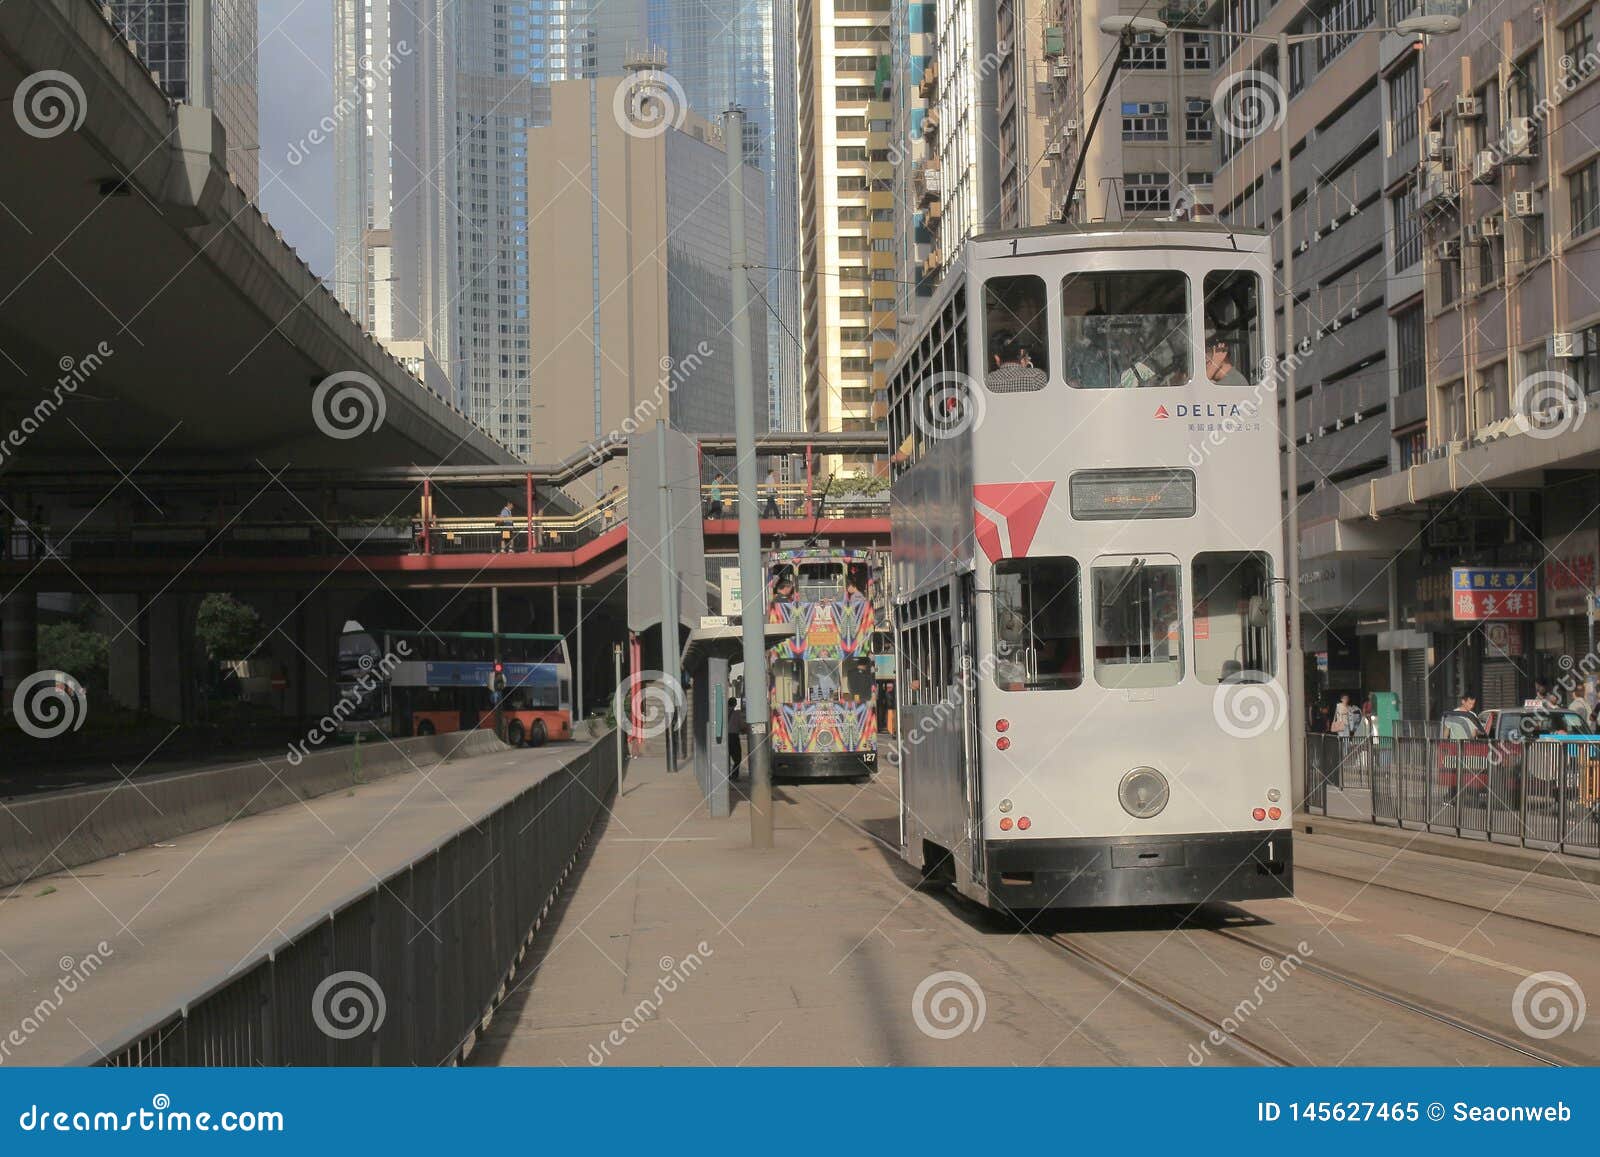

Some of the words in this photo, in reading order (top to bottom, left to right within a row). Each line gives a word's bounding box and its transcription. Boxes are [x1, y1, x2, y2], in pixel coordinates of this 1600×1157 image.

[1008, 239, 1018, 256] 1
[1226, 234, 1237, 251] 1
[1176, 403, 1241, 417] DELTA
[863, 753, 876, 763] 127
[1267, 841, 1274, 861] 1
